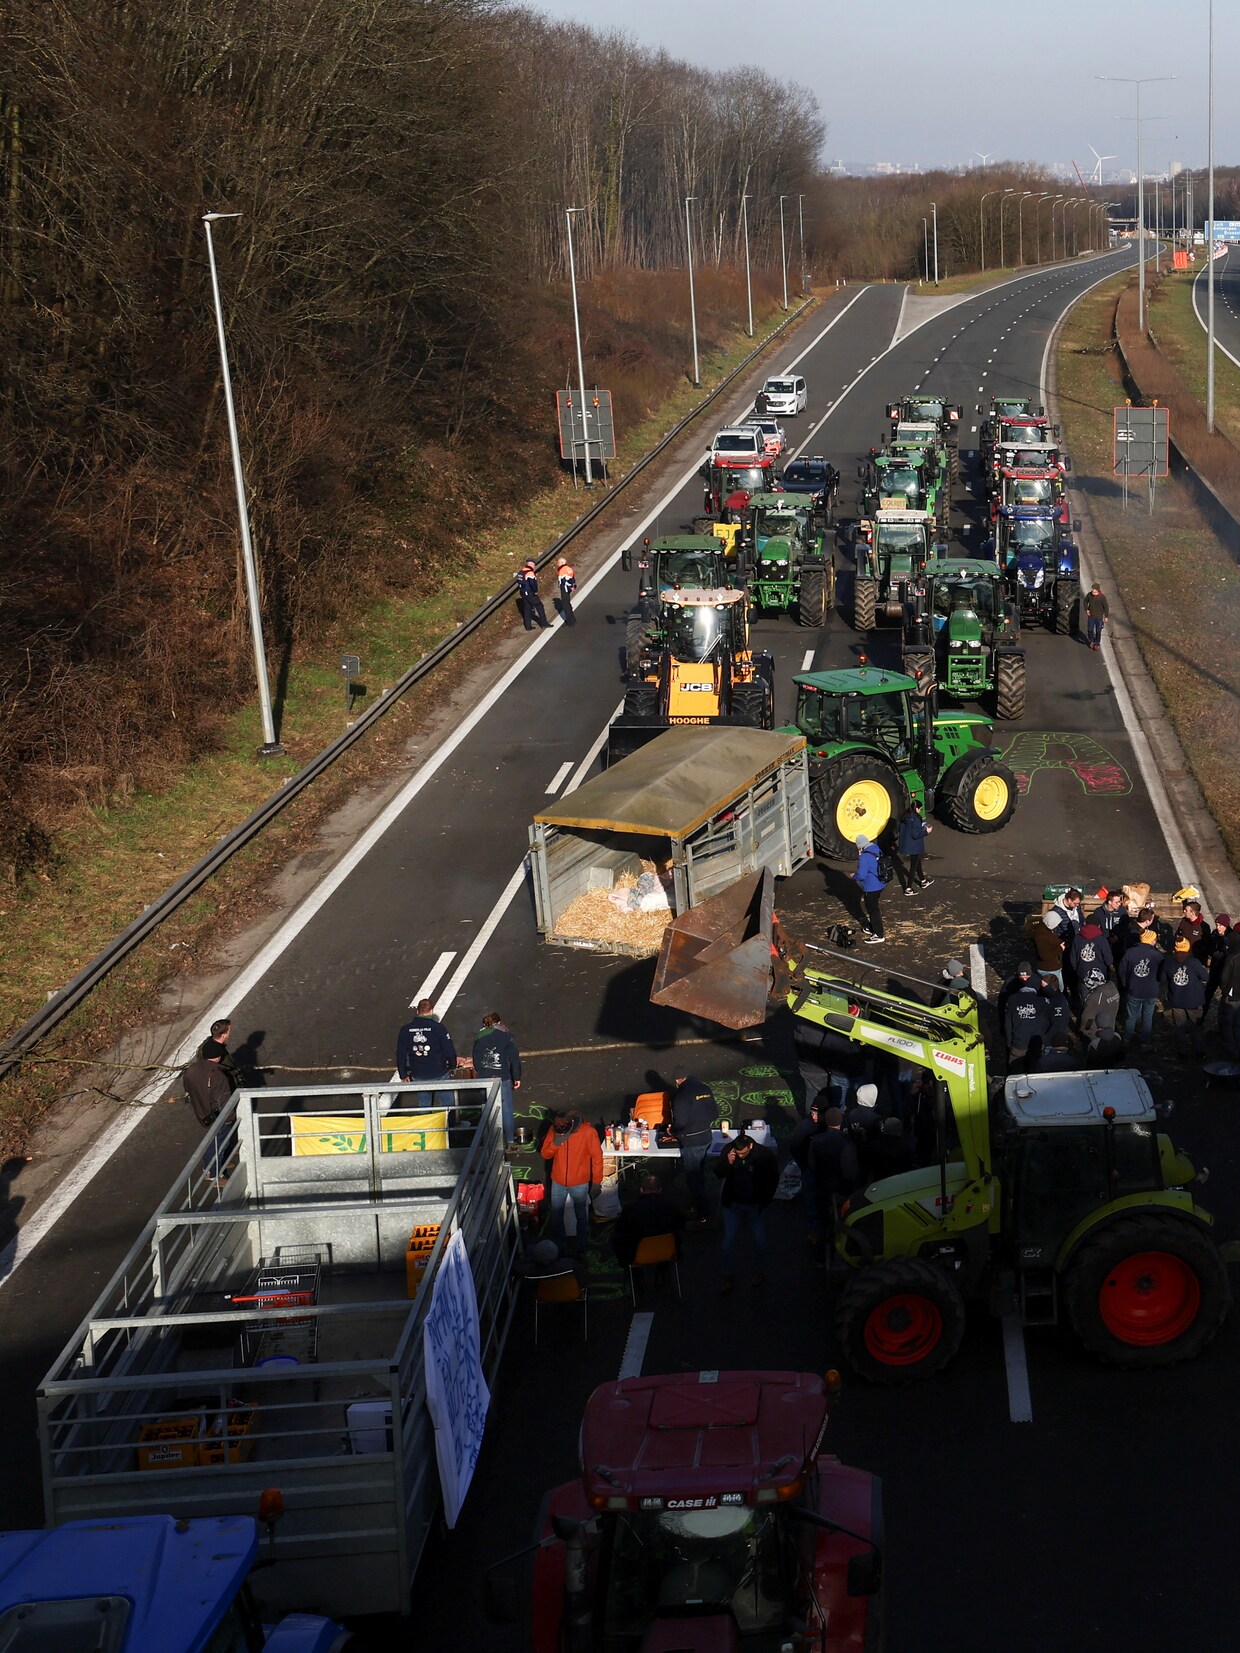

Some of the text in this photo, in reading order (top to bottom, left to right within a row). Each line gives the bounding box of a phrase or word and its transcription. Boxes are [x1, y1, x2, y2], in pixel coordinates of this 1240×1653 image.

[680, 683, 713, 692] JCB
[669, 717, 710, 725] HOOGHE
[935, 1051, 965, 1066] CLAAS
[152, 1452, 180, 1461] Jupiler
[667, 1499, 703, 1509] CASE
